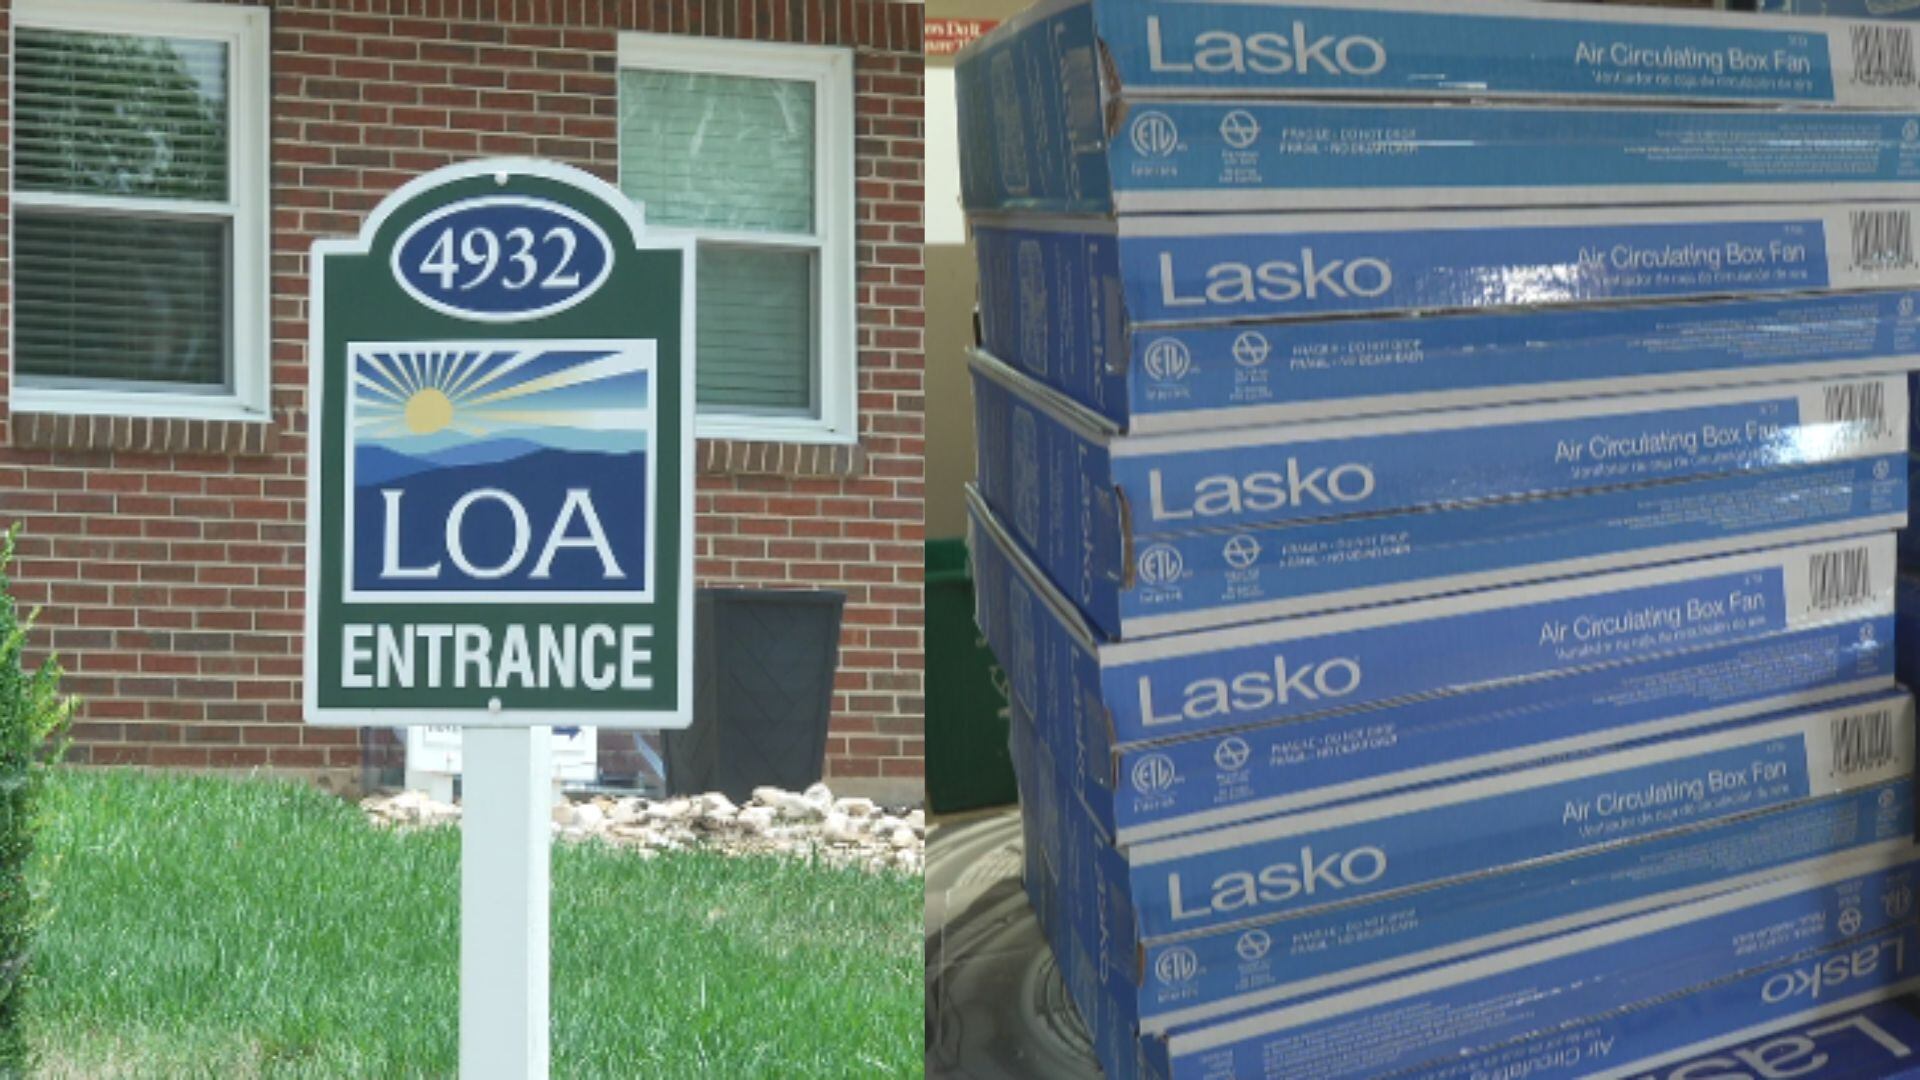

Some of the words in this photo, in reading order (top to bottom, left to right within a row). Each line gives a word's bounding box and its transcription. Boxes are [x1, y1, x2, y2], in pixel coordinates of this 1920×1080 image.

[1147, 15, 1386, 76] Lasko
[1575, 41, 1604, 64] Air
[1610, 42, 1723, 74] Circulating
[1727, 47, 1768, 70] Box
[1774, 50, 1810, 73] Fan
[420, 227, 580, 291] 4932
[1159, 248, 1392, 307] Lasko
[1578, 244, 1604, 267] Air
[1610, 243, 1721, 270] Circulating
[1726, 241, 1766, 264] Box
[1771, 240, 1806, 263] Fan
[1555, 439, 1583, 464] Air
[1589, 430, 1698, 459] Circulating
[1703, 425, 1742, 448] Box
[1148, 457, 1375, 521] Lasko
[379, 487, 627, 580] LOA
[1539, 621, 1568, 646] Air
[1573, 605, 1682, 640] Circulating
[1687, 598, 1725, 621] Box
[1730, 590, 1765, 611] Fan
[341, 624, 654, 690] ENTRANCE
[1138, 655, 1362, 727] Lasko
[1562, 801, 1589, 826] Air
[1596, 778, 1704, 817] Circulating
[1708, 769, 1748, 793] Box
[1753, 761, 1787, 784] Fan
[1168, 846, 1388, 921] Lasko
[1761, 935, 1905, 1003] Lasko
